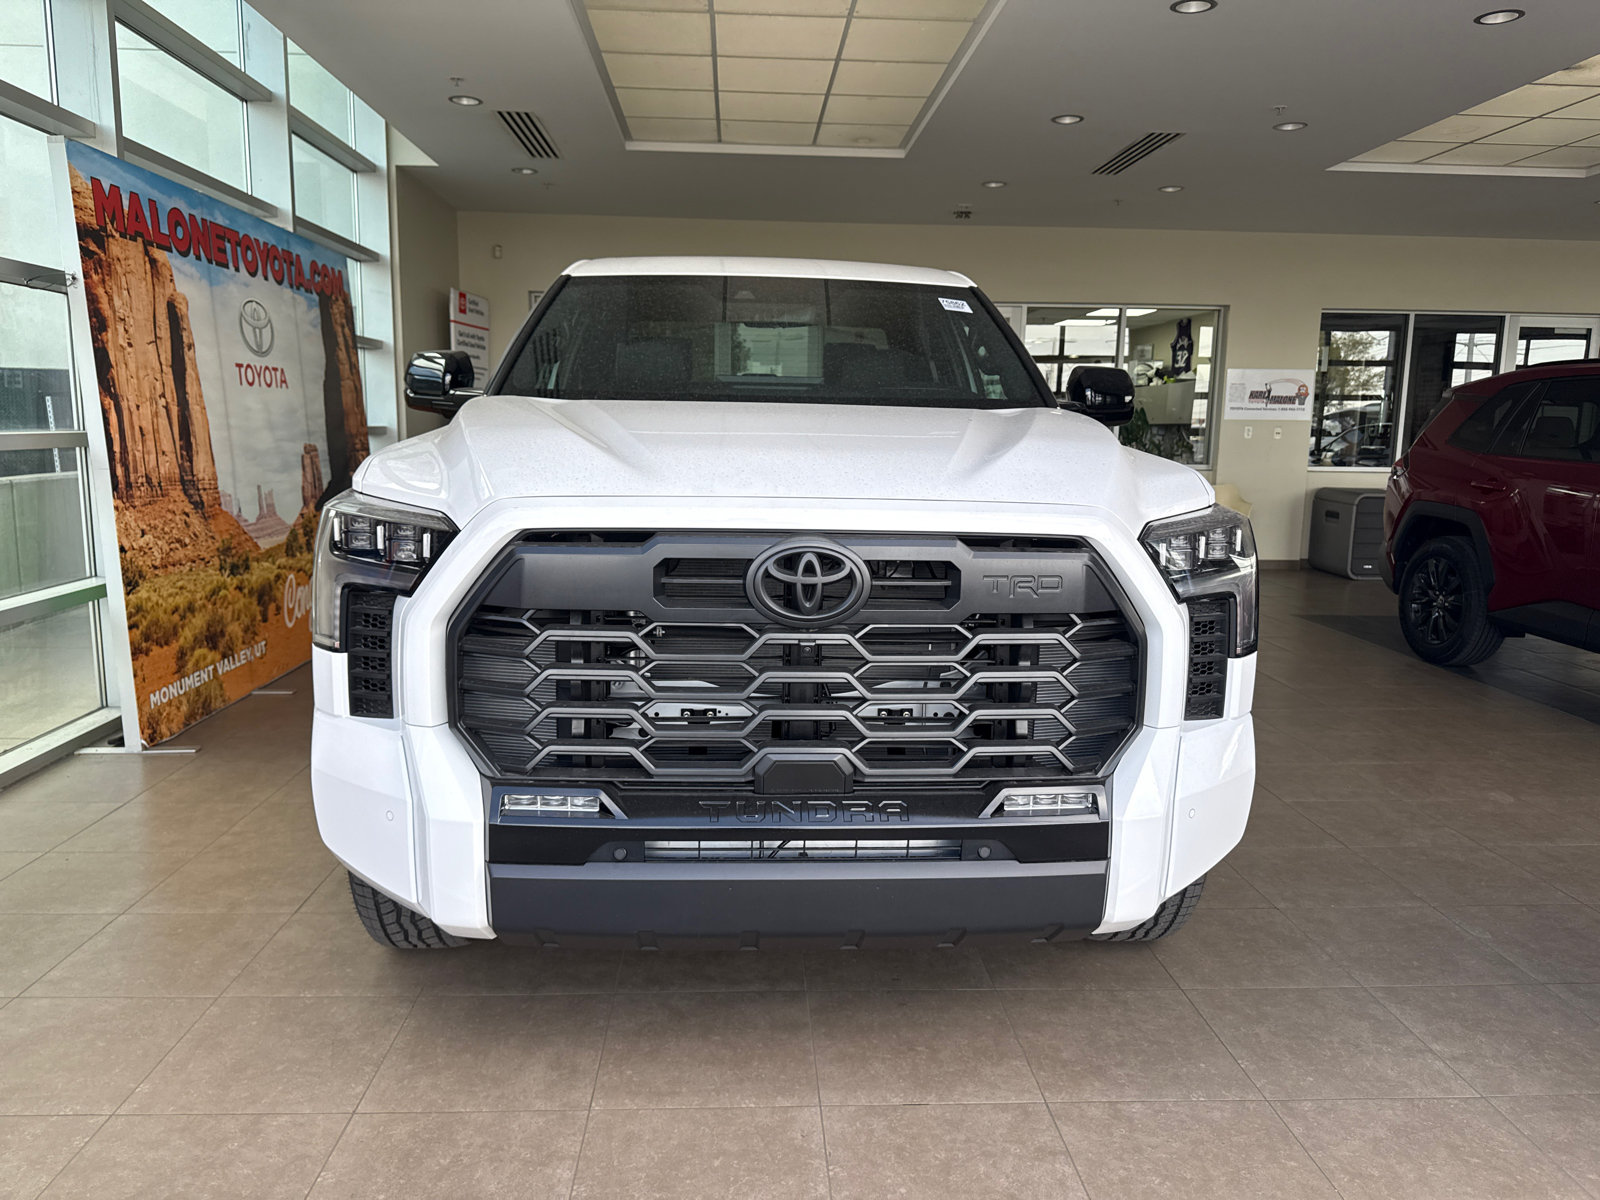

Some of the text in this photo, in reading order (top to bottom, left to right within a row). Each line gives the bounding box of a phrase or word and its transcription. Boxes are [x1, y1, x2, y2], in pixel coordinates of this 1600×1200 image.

[91, 177, 346, 297] MALONETOYOTA.COM
[1175, 351, 1188, 368] 32
[235, 362, 289, 389] TOYOTA
[1249, 390, 1267, 400] KARL
[1269, 395, 1296, 404] MALONE
[983, 575, 1063, 598] TRD
[150, 662, 214, 709] MONUMENT
[253, 640, 267, 655] UT
[699, 801, 909, 822] TUNDRA
